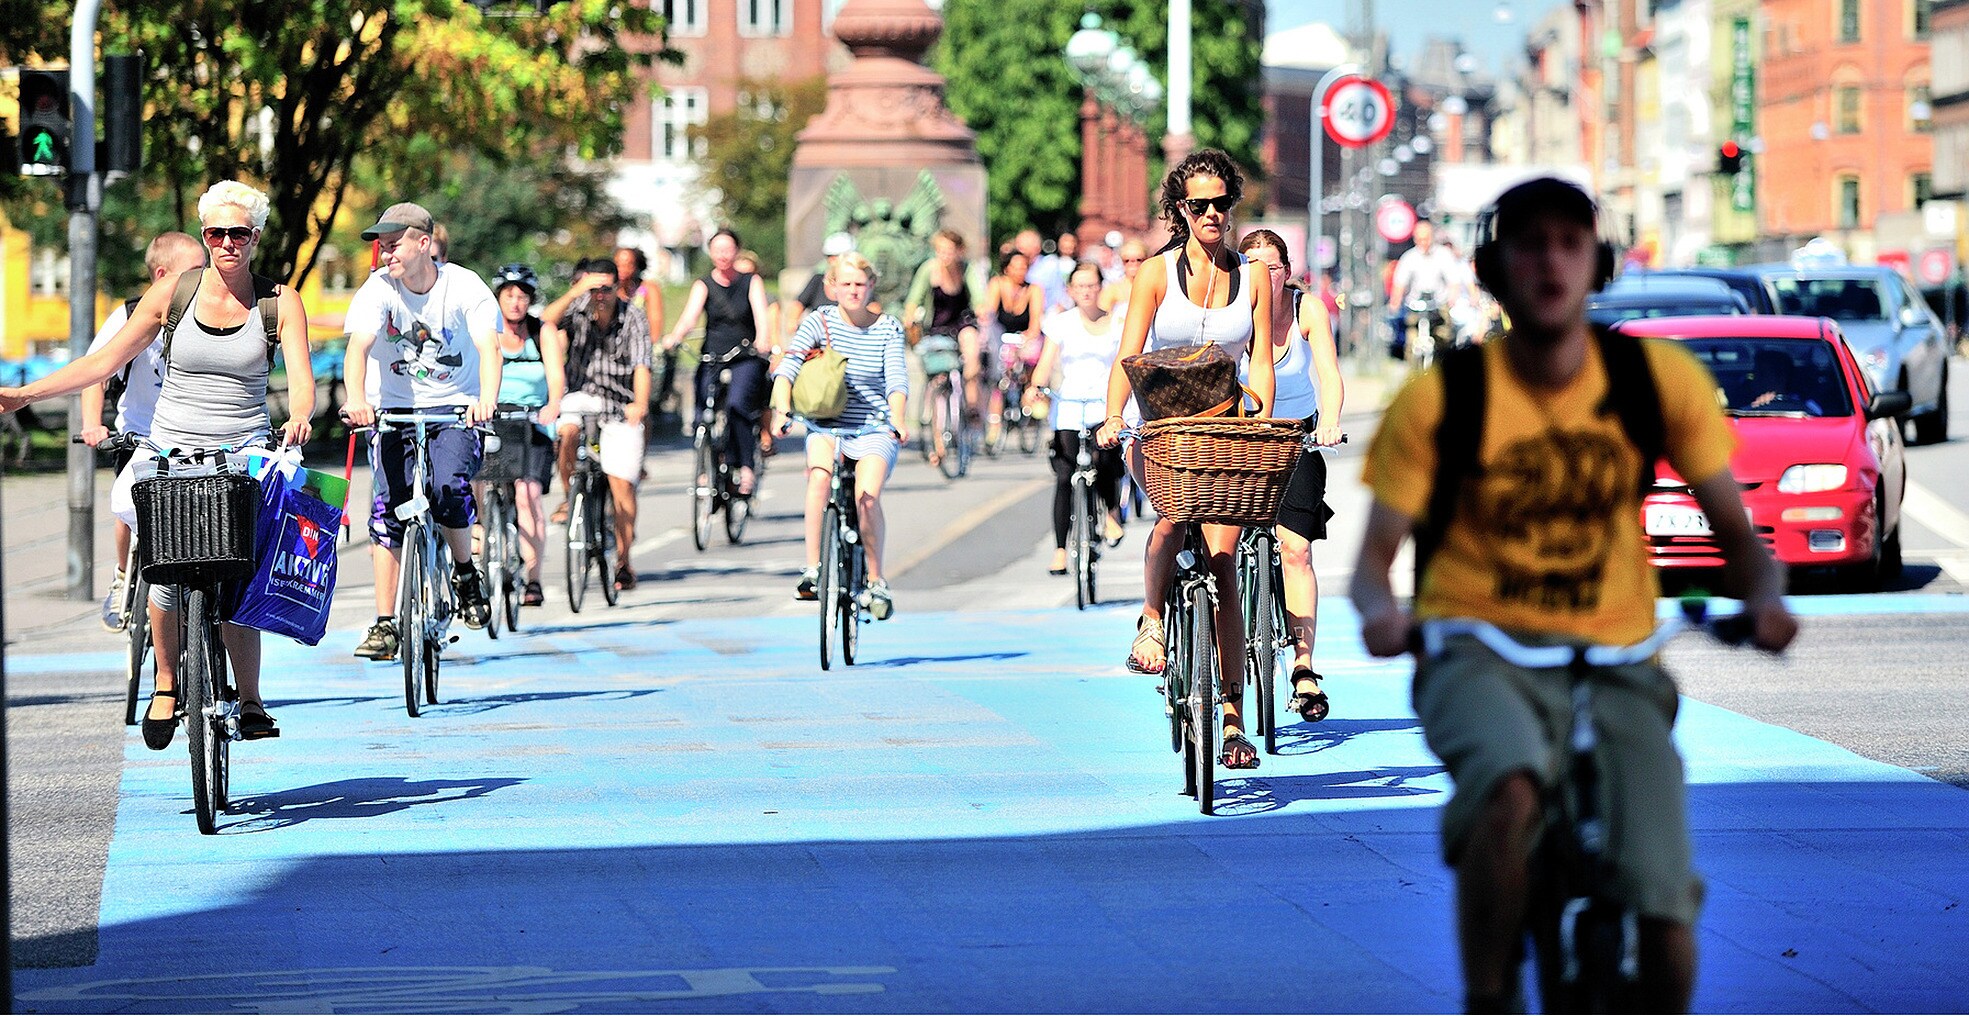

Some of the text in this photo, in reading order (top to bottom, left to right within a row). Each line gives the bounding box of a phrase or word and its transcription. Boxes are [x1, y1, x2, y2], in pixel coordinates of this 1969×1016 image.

[1340, 99, 1376, 127] 40
[302, 526, 320, 542] DIN
[270, 577, 326, 602] ISEKRÆMMER
